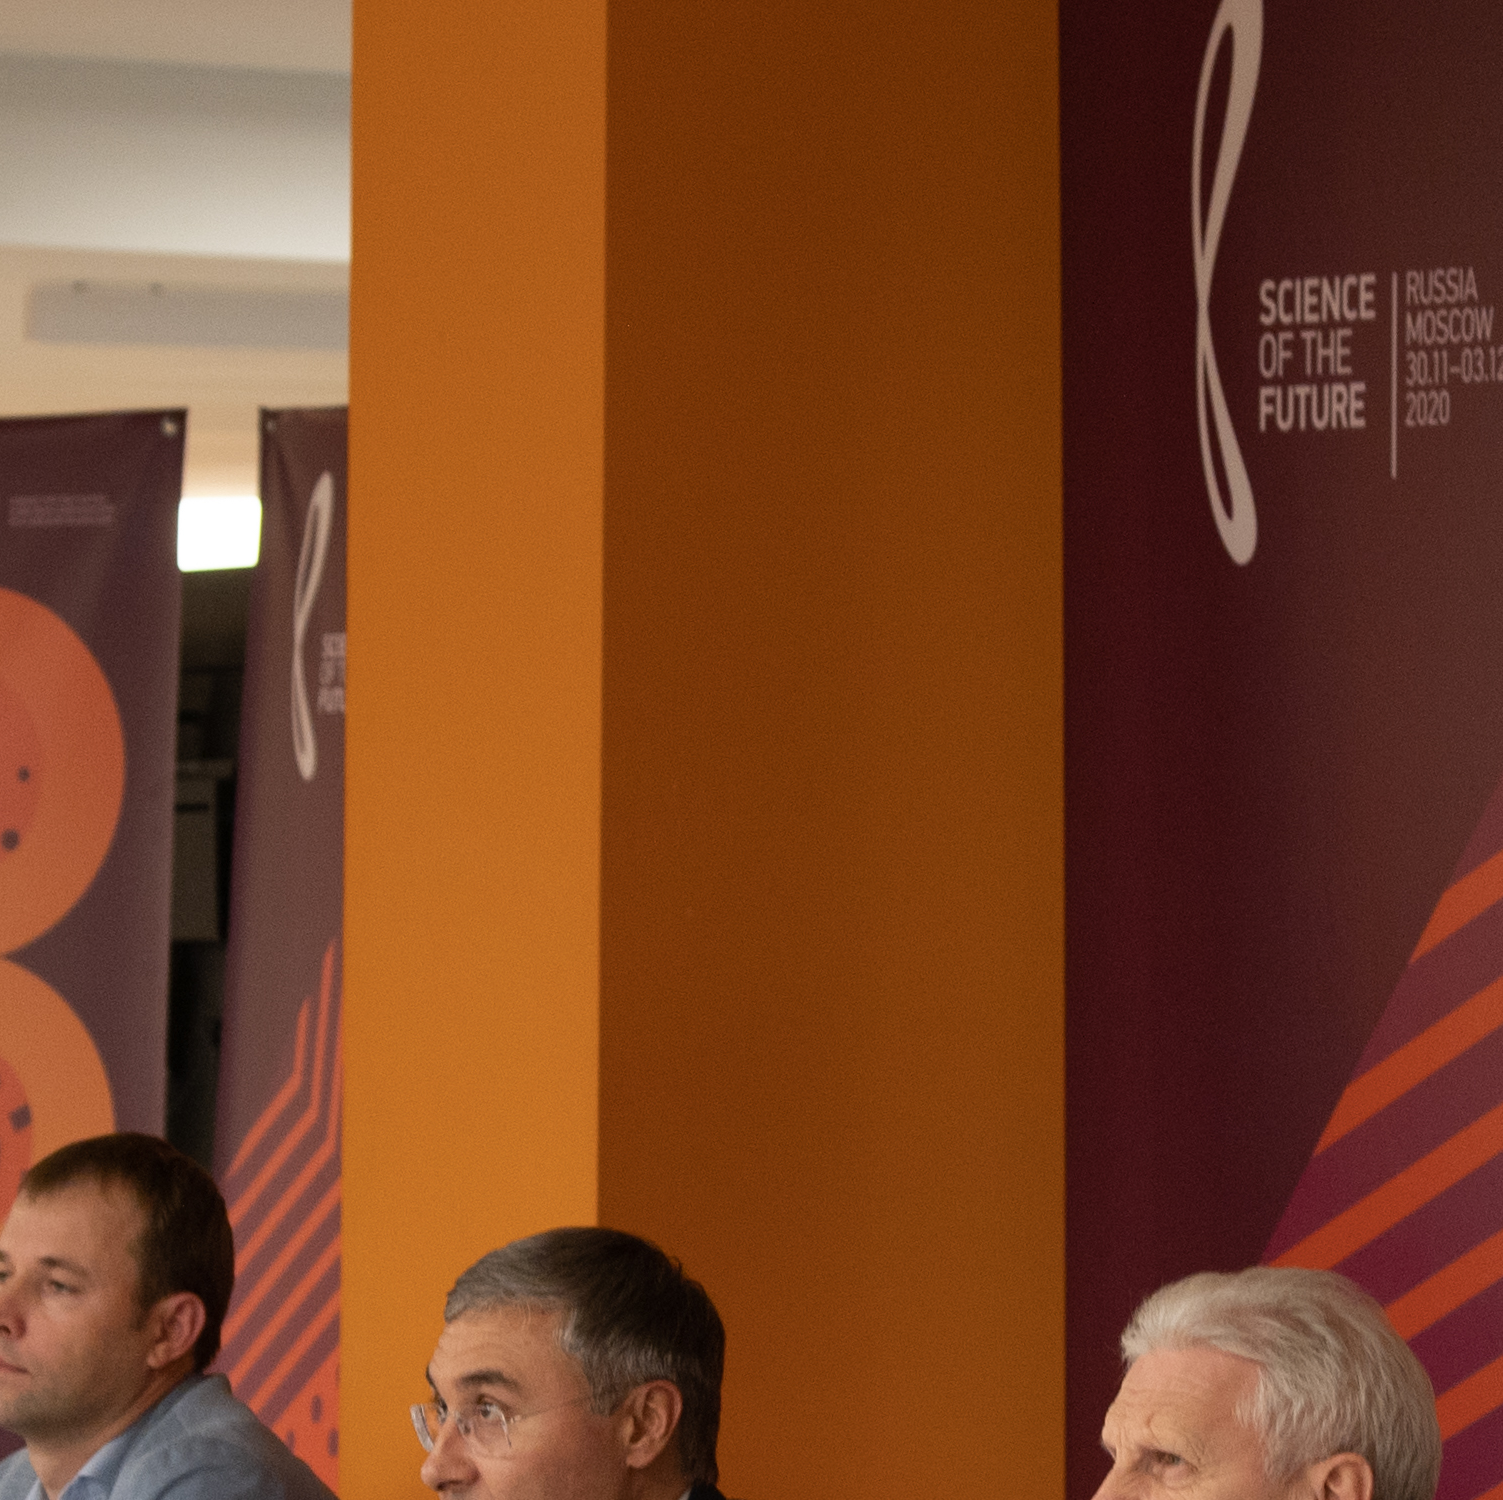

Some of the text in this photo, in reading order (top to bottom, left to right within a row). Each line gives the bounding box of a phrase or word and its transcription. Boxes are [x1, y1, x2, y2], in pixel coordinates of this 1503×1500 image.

[1259, 274, 1376, 325] SCIENCE
[1406, 268, 1478, 304] RUSSIA
[1406, 306, 1495, 345] MOSCOW
[1259, 328, 1352, 378] OF THE
[1259, 382, 1366, 432] FUTURE
[1405, 388, 1450, 427] 2020
